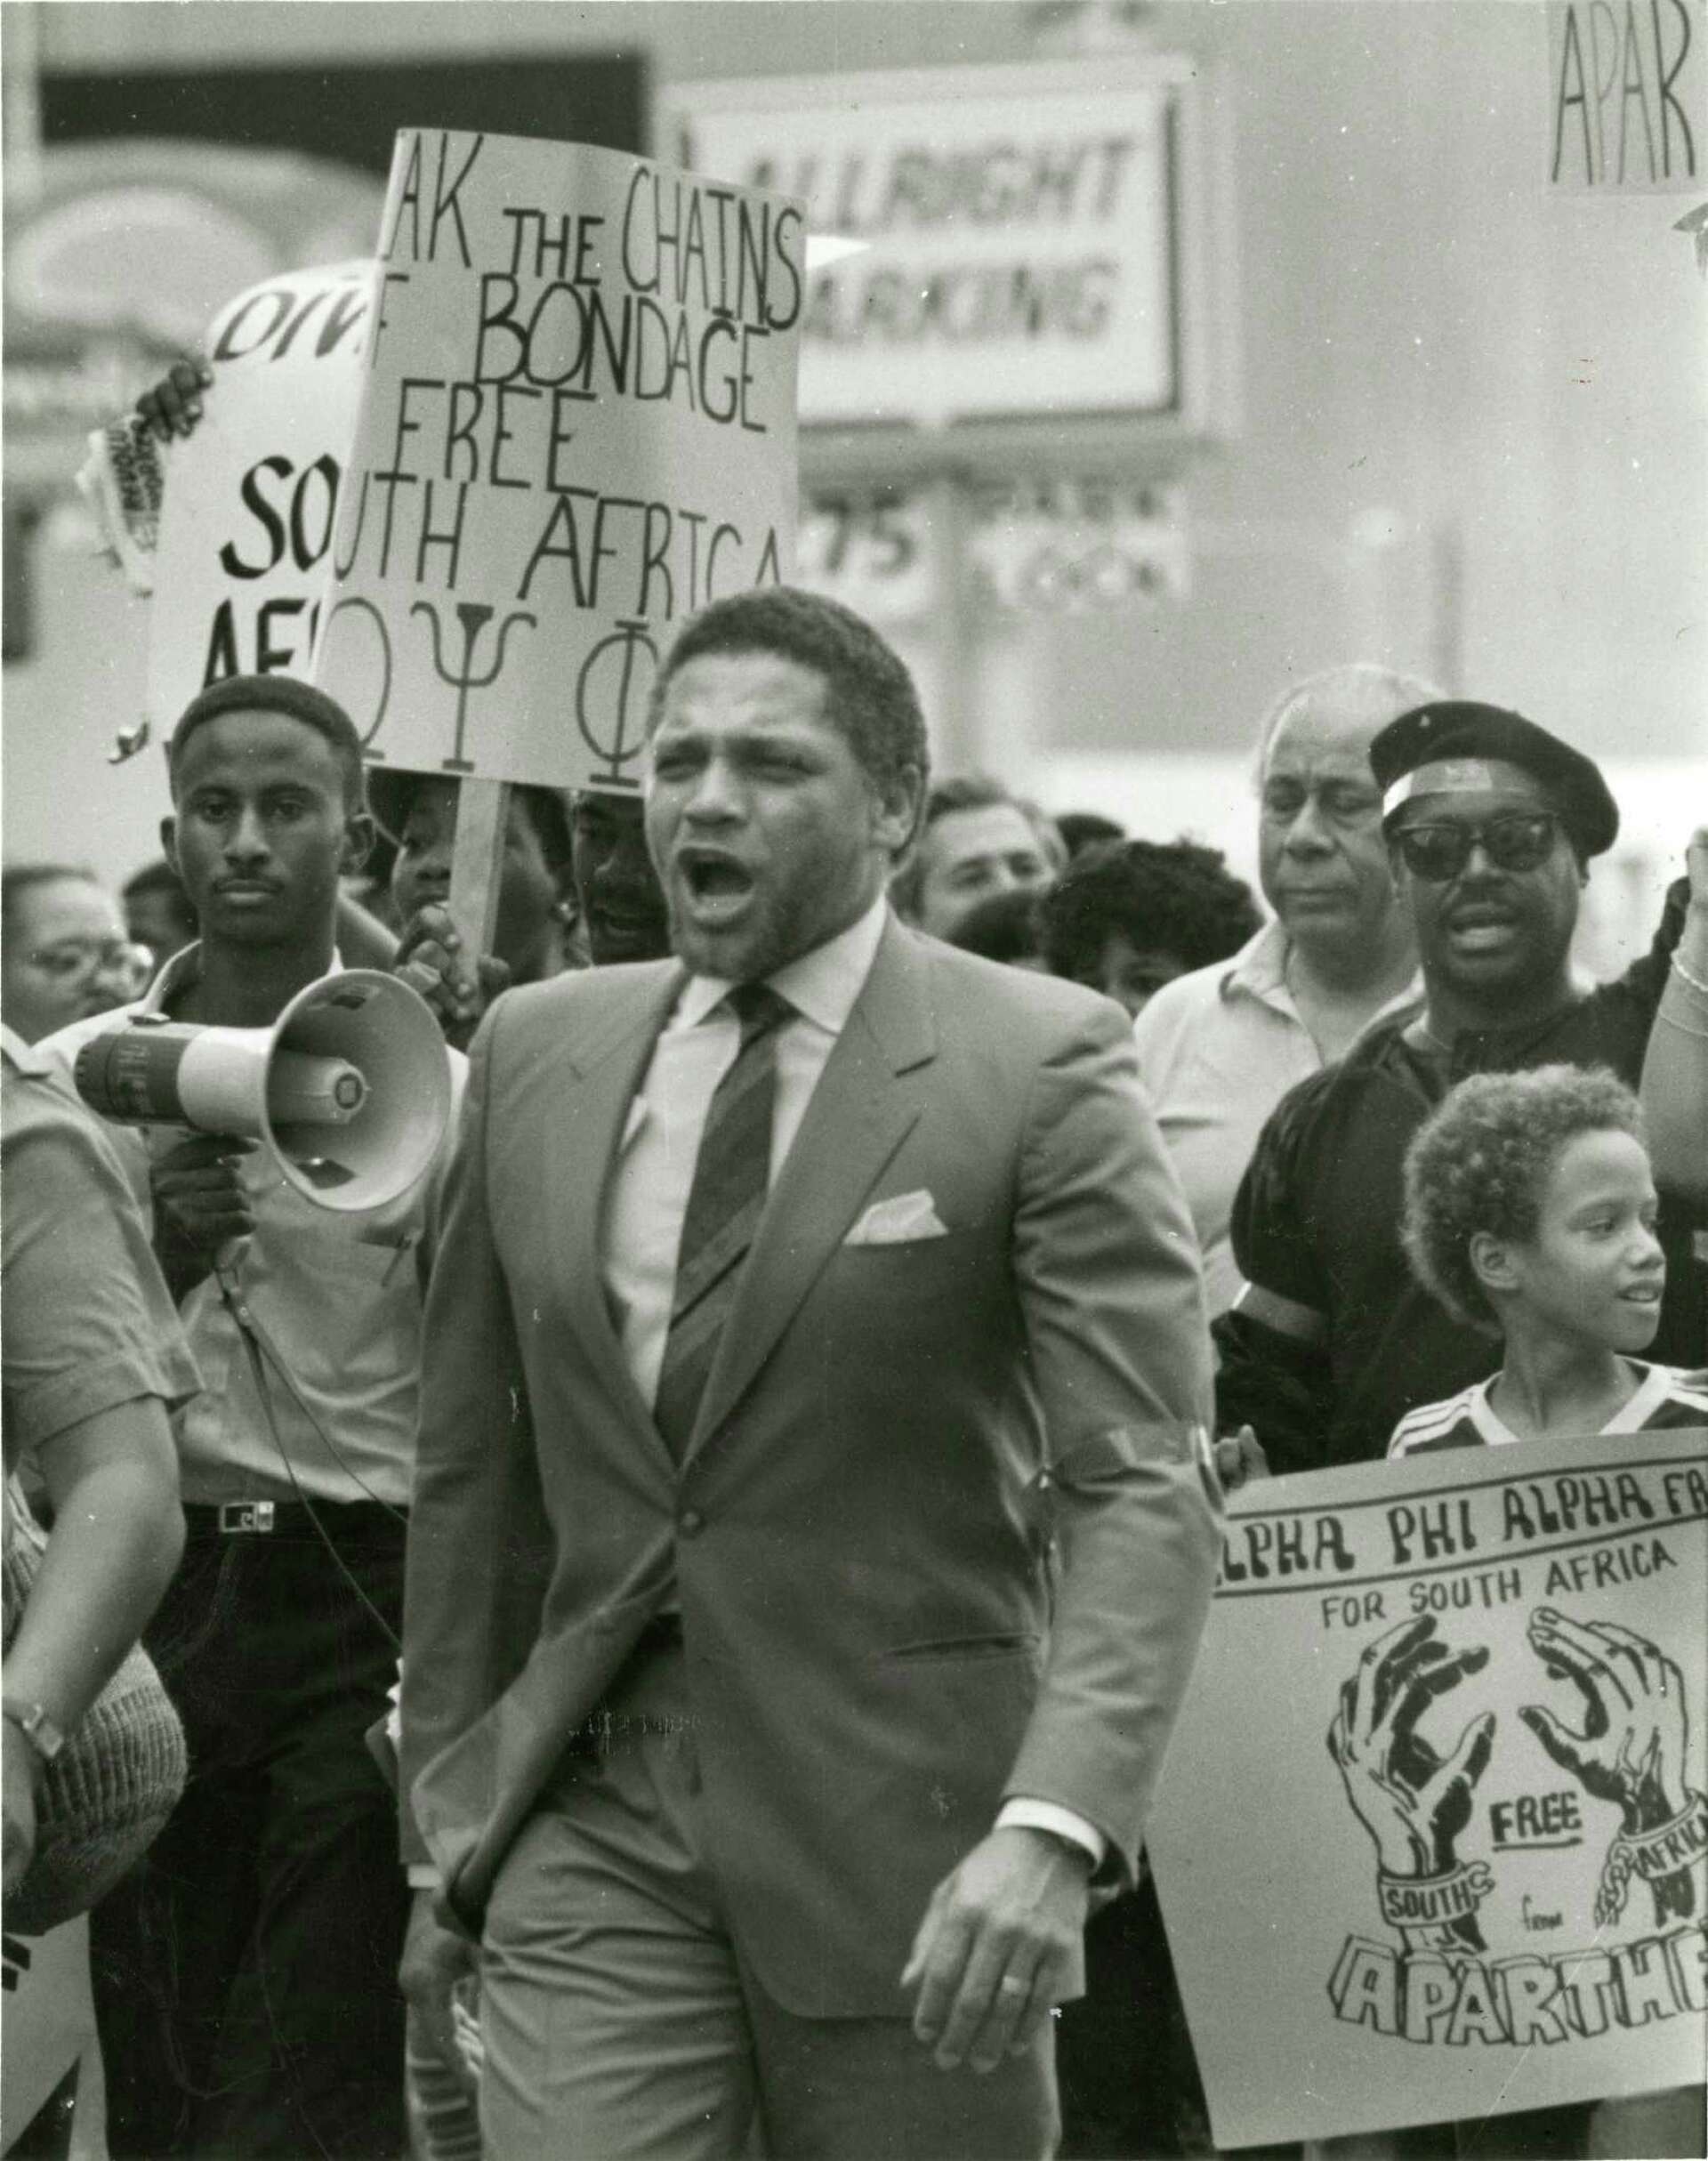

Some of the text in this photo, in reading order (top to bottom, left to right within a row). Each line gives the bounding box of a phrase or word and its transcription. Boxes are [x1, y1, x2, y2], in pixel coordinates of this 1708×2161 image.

[1551, 0, 1696, 185] APAR
[747, 133, 1134, 231] LLRIGHT
[503, 207, 604, 286] THE
[623, 166, 802, 331] CHAINS
[214, 287, 367, 362] DIV
[474, 272, 770, 433] BONDAGE
[390, 378, 598, 498] FREE
[219, 452, 340, 580] SO
[334, 471, 468, 590] UTH
[202, 596, 321, 689] AF
[1215, 1515, 1355, 1587] LPHA
[1387, 1498, 1477, 1564] PHI
[1503, 1472, 1655, 1543] ALPHA
[1321, 1538, 1678, 1629] FOR SOUTH AFRICA
[1489, 1790, 1583, 1844] FREE
[1386, 1881, 1473, 1919] SOUTH
